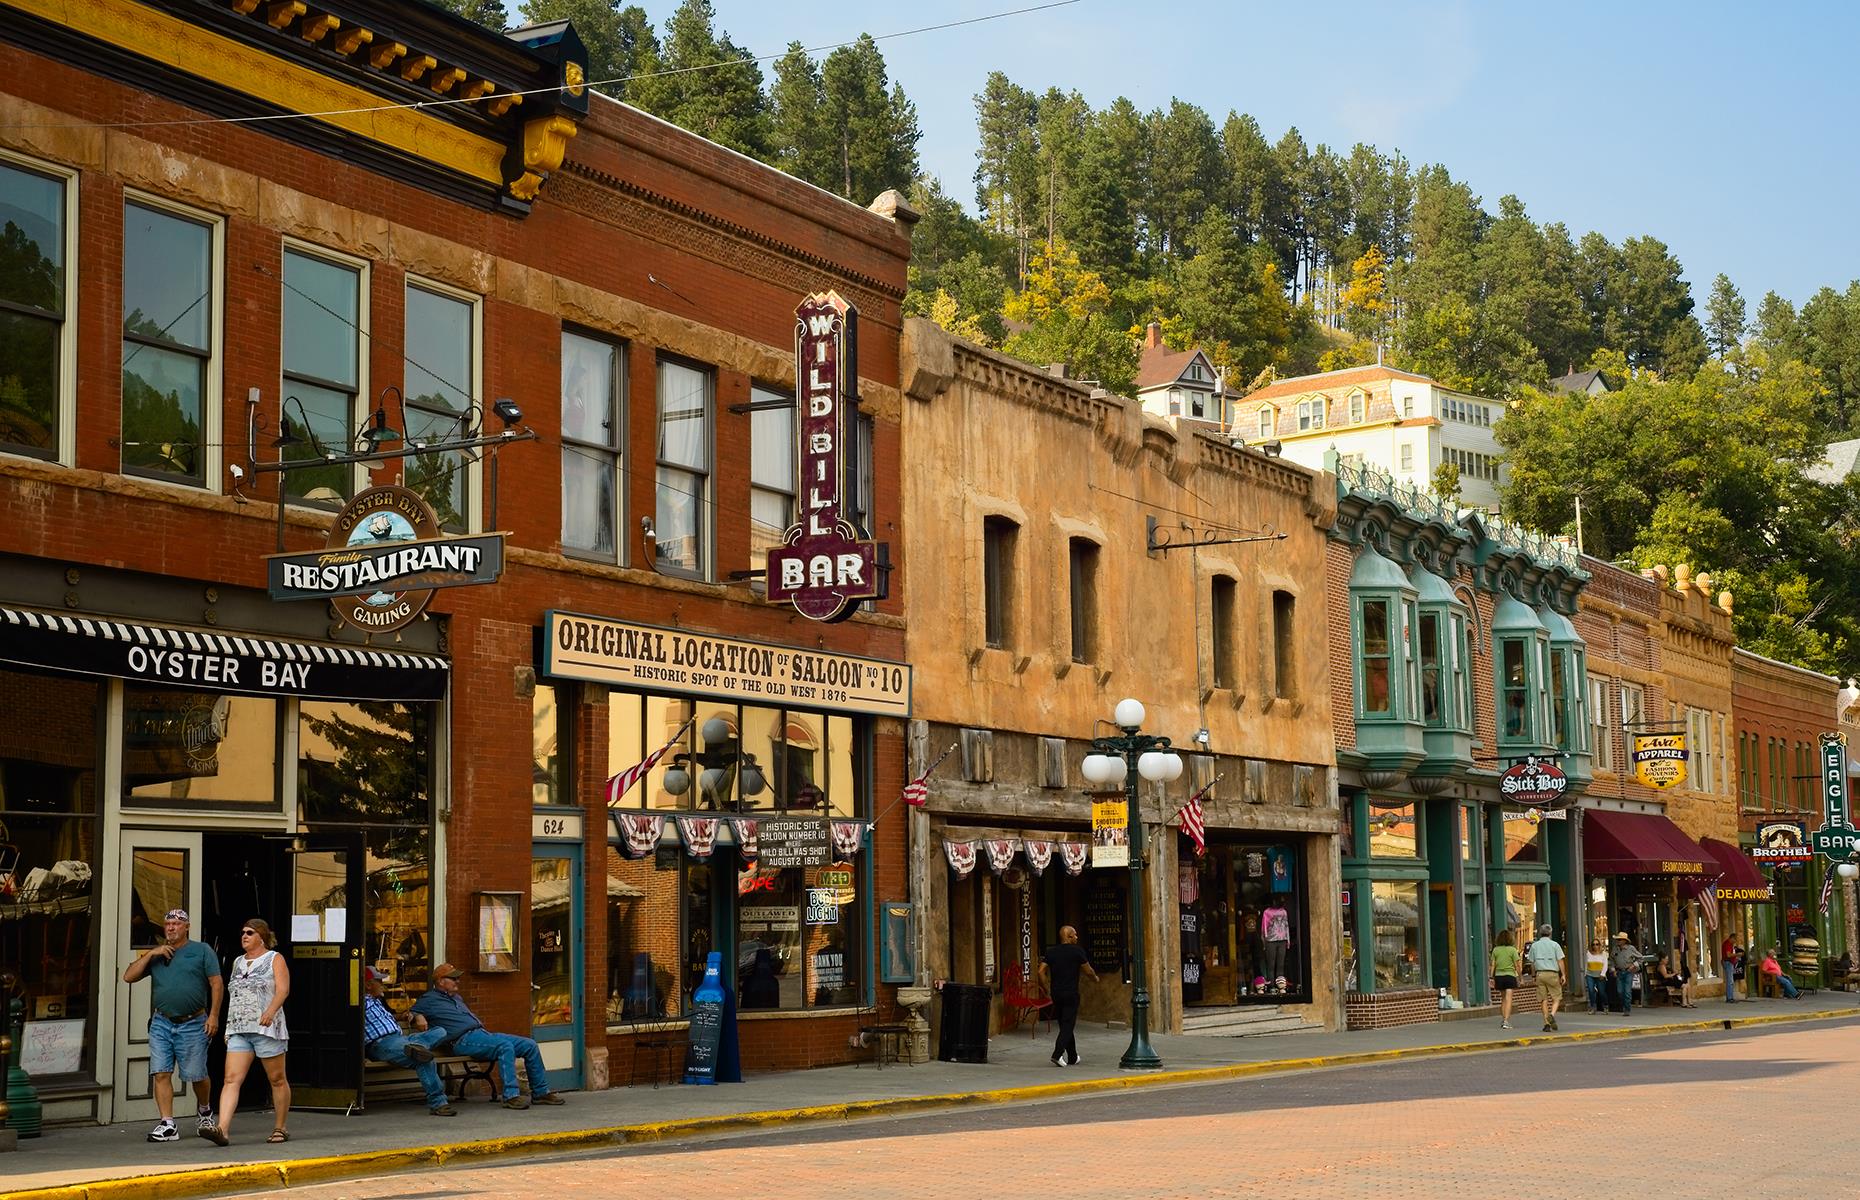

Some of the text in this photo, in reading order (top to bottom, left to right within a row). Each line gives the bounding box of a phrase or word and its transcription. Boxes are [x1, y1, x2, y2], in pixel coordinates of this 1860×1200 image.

[808, 313, 835, 536] WILD BILL
[340, 491, 427, 531] OYSTER BAY
[318, 551, 372, 568] Family
[282, 545, 481, 591] RESTAURANT
[781, 553, 865, 591] BAR
[353, 601, 411, 626] GAMING
[558, 619, 667, 664] ORIGINAL
[672, 636, 774, 677] LOCATION
[792, 653, 863, 689] SALOON
[881, 667, 903, 694] 10
[127, 646, 312, 689] OYSTER BAY
[633, 664, 847, 702] HISTORIC SPOT OF THE OLD WEST 1876
[1642, 738, 1677, 748] Ava
[1638, 749, 1684, 760] APPAREL
[186, 757, 218, 772] CASINO
[1501, 774, 1566, 794] Sick Boy
[1828, 754, 1842, 828] EAGLE
[543, 819, 565, 834] 624
[766, 821, 820, 831] HISTORIC SITE
[760, 831, 826, 841] SALOON NUMBER 10
[1820, 835, 1856, 848] BAR
[761, 846, 827, 857] WILD BILL WAS SHOT
[1752, 846, 1811, 857] BROTHEL
[768, 857, 820, 866] AUGUST 2 1876
[810, 891, 832, 907] BUD
[806, 906, 837, 921] LIGHT
[1021, 880, 1032, 975] WELCOME
[830, 953, 843, 967] YOU
